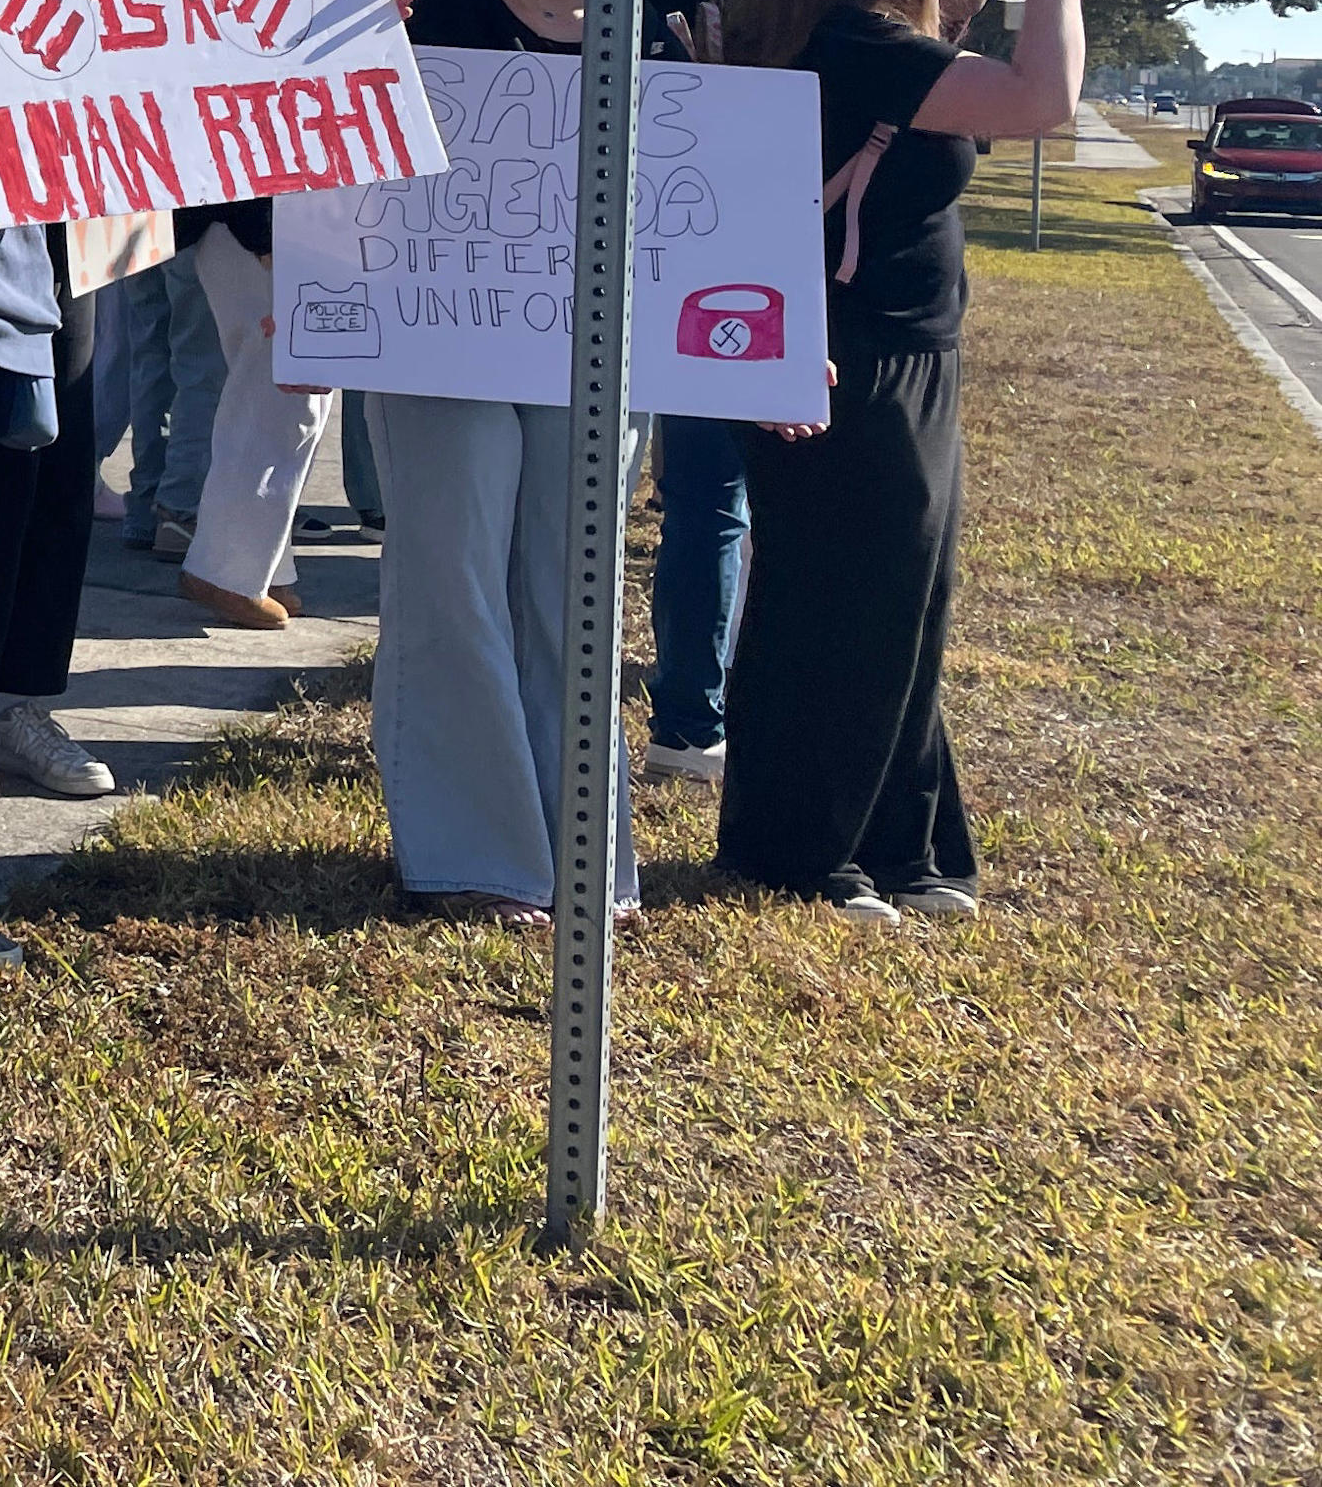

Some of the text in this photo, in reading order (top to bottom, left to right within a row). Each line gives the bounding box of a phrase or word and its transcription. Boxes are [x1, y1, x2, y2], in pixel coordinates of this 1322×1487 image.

[413, 52, 703, 159] SAE
[193, 68, 415, 199] RIGHT
[358, 235, 667, 283] DIFFERT
[316, 316, 362, 332] ICE
[396, 285, 575, 336] UNIFO
